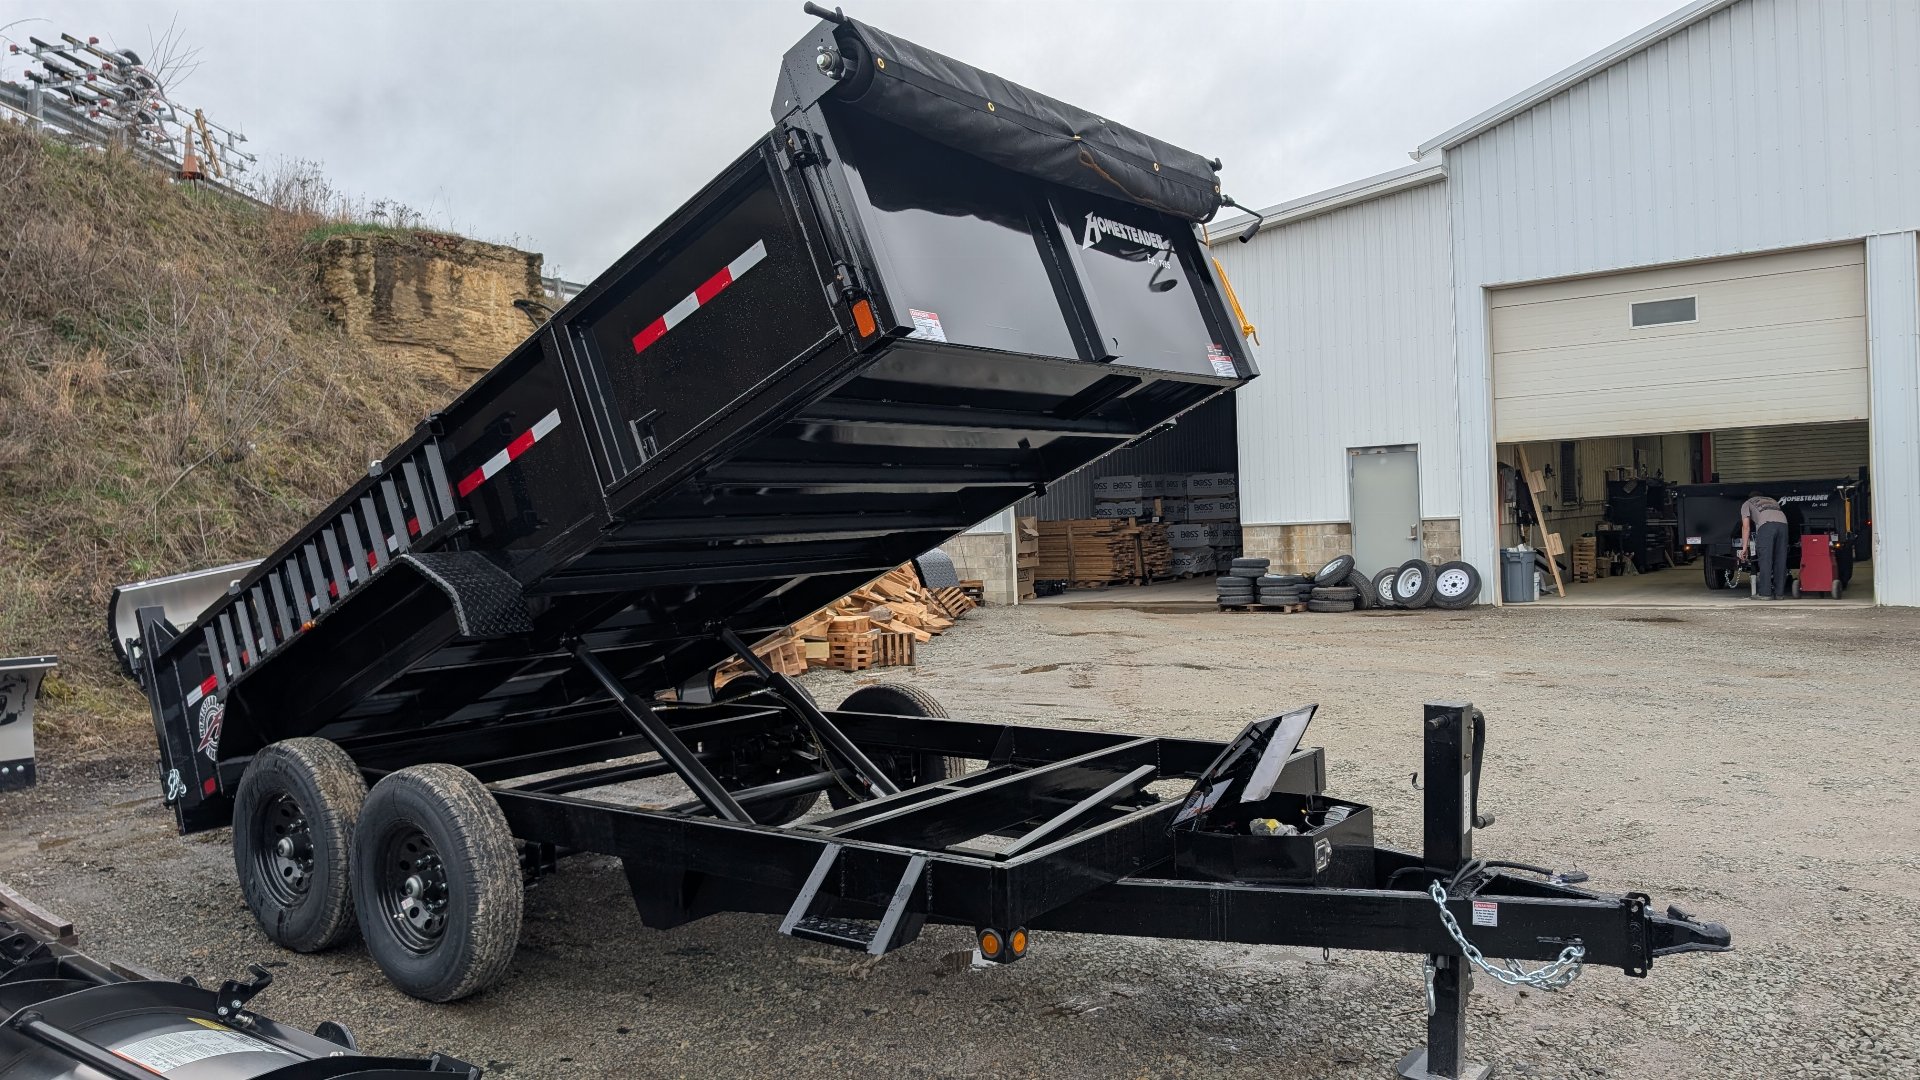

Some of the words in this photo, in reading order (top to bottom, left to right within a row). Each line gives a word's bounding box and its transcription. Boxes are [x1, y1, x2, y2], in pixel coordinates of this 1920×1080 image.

[1082, 211, 1164, 250] HOMESTEADER
[1113, 481, 1132, 490] BOSS
[1193, 479, 1213, 487] BOSS
[1778, 494, 1828, 506] HOMESTEADER
[1117, 507, 1137, 516] BOSS
[1194, 503, 1214, 511] BOSS
[1180, 530, 1199, 539] BOSS
[1171, 558, 1191, 566] BOSS
